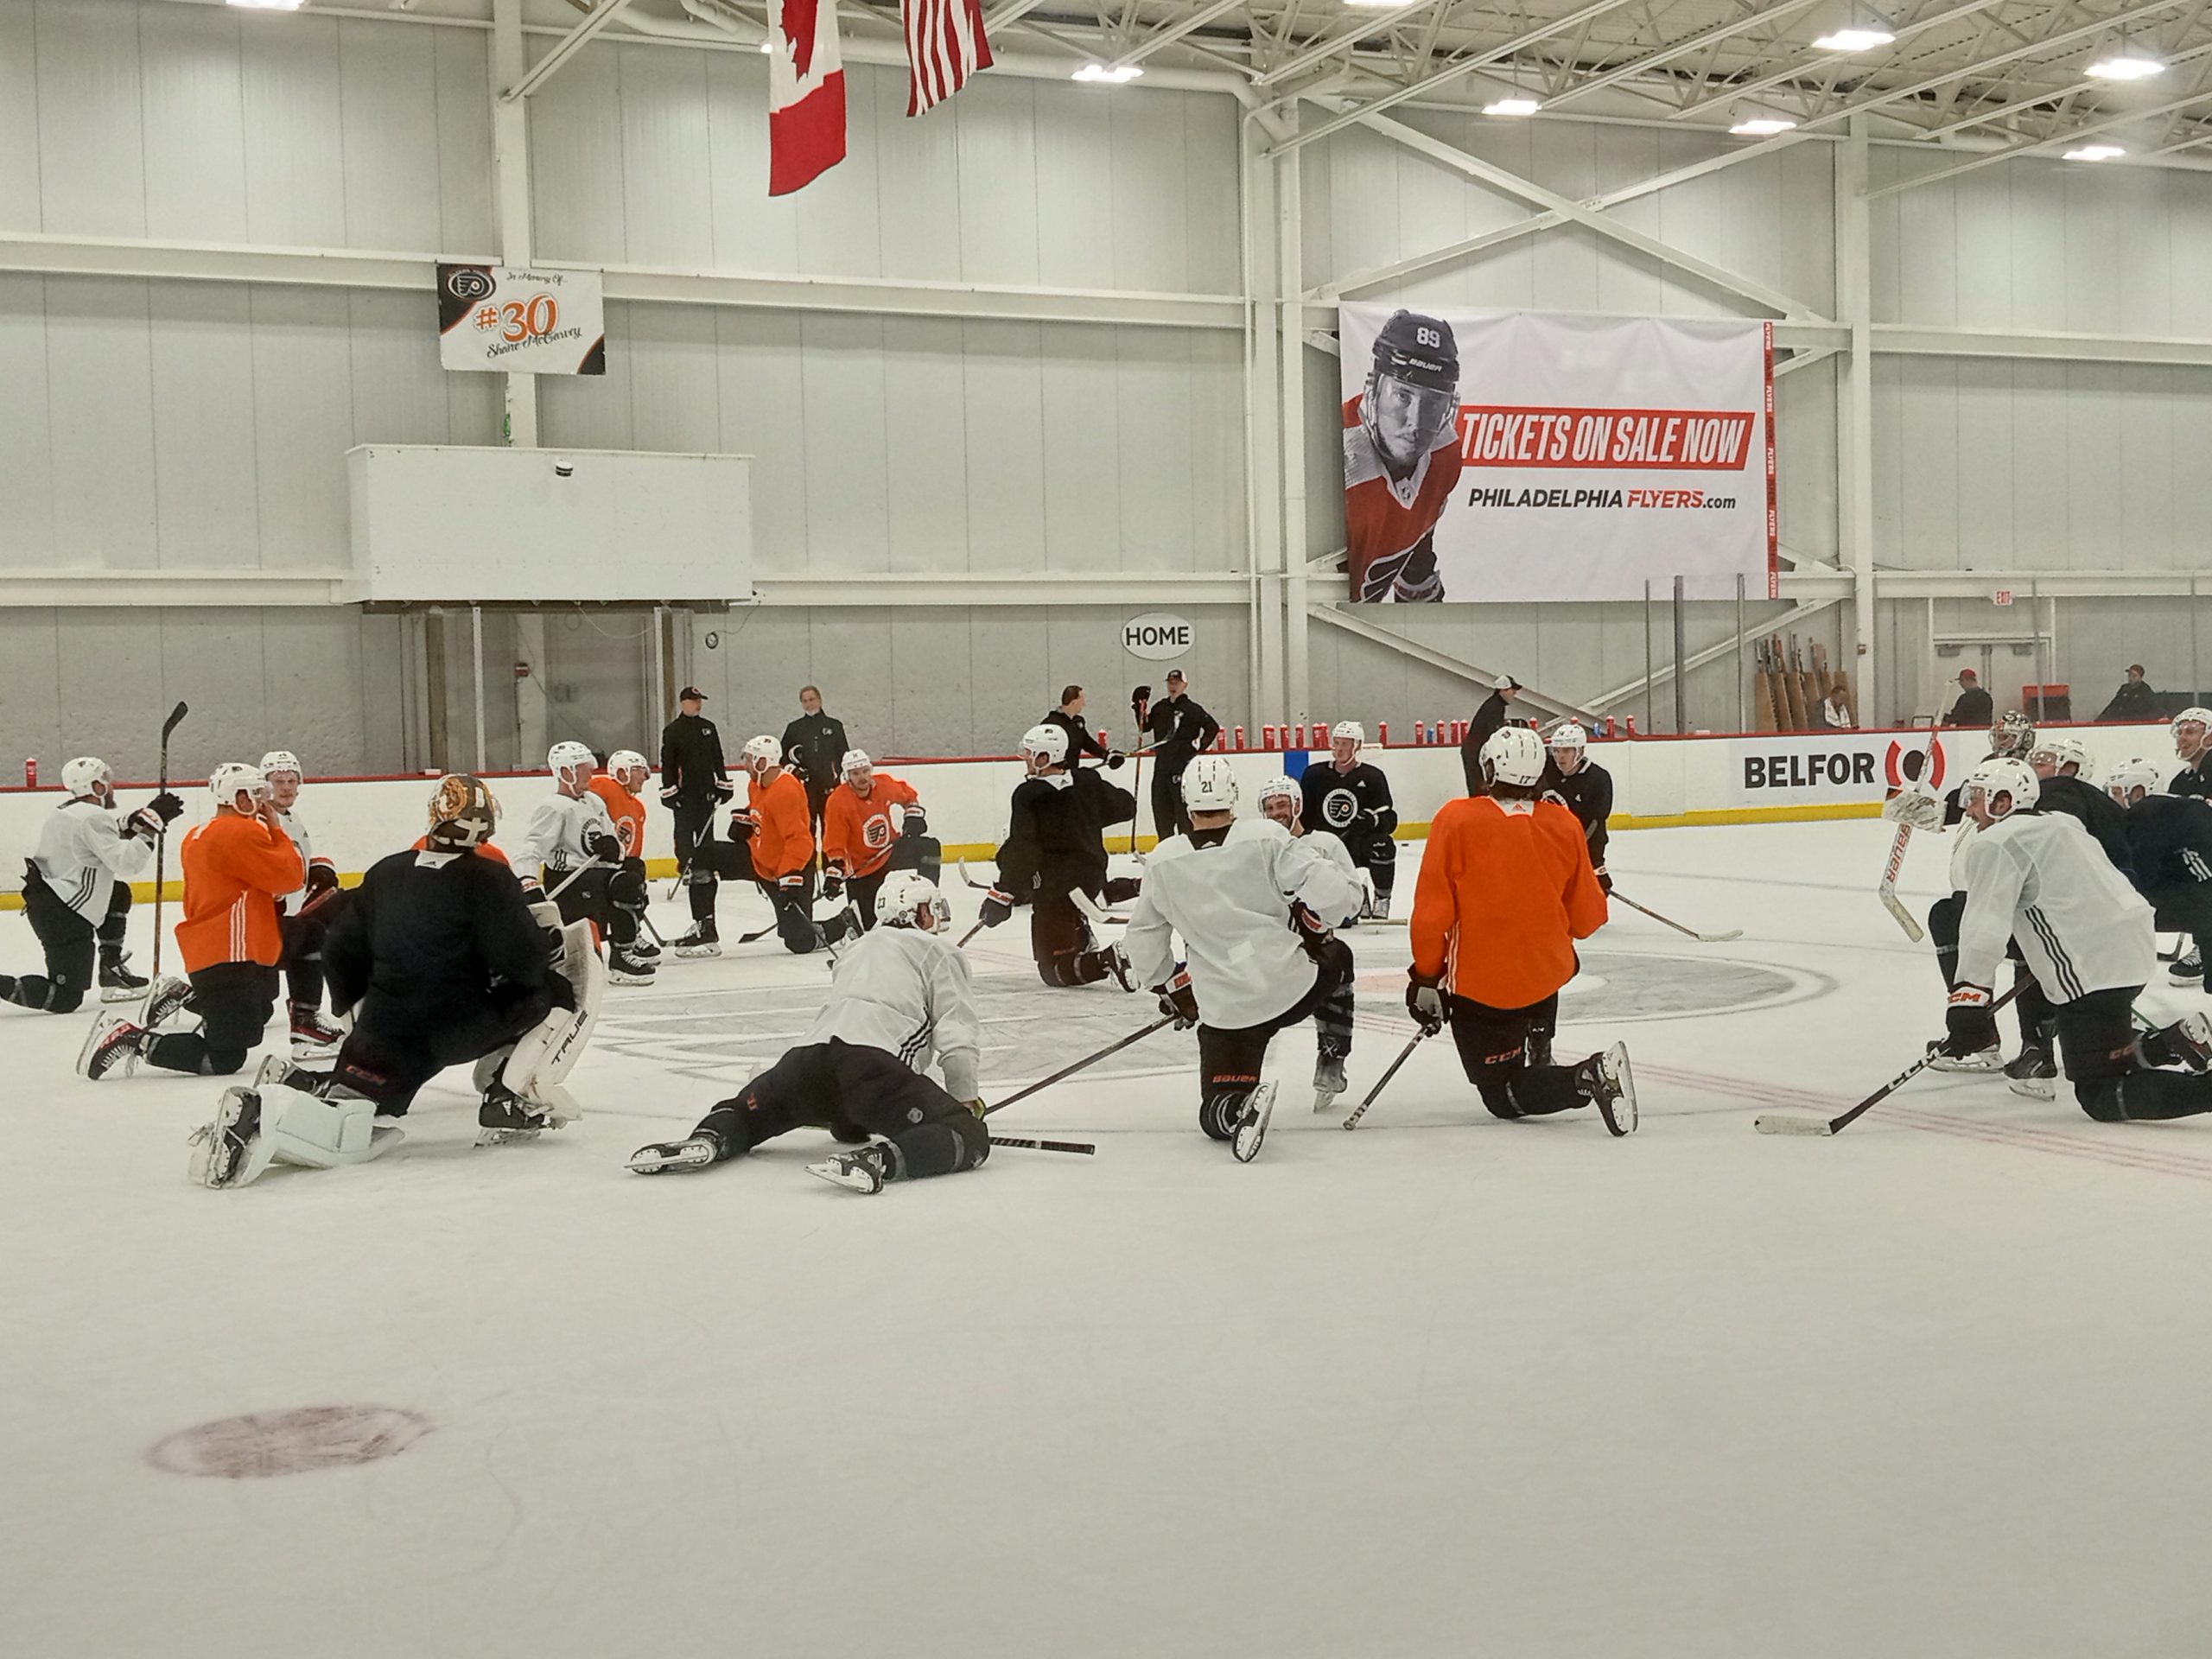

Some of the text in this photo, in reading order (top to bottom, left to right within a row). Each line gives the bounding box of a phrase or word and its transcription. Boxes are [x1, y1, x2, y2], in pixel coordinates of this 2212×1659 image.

[475, 294, 557, 343] #30
[1416, 327, 1441, 349] 89
[1408, 358, 1443, 373] BAUER
[1461, 412, 1573, 461] TICKETS
[1572, 415, 1614, 462] ON
[1612, 416, 1681, 463] SALE
[1680, 418, 1746, 464] NOW
[1469, 488, 1737, 509] PHILADELPHIA FLYERS.com
[1126, 626, 1190, 646] HOME
[1519, 775, 1532, 785] 17
[1745, 752, 1875, 789] BELFOR
[1201, 780, 1213, 793] 21
[1948, 992, 1981, 1004] CM
[550, 1009, 588, 1065] TRUE
[1484, 1046, 1522, 1065] CCM
[1887, 1046, 1941, 1090] CCM
